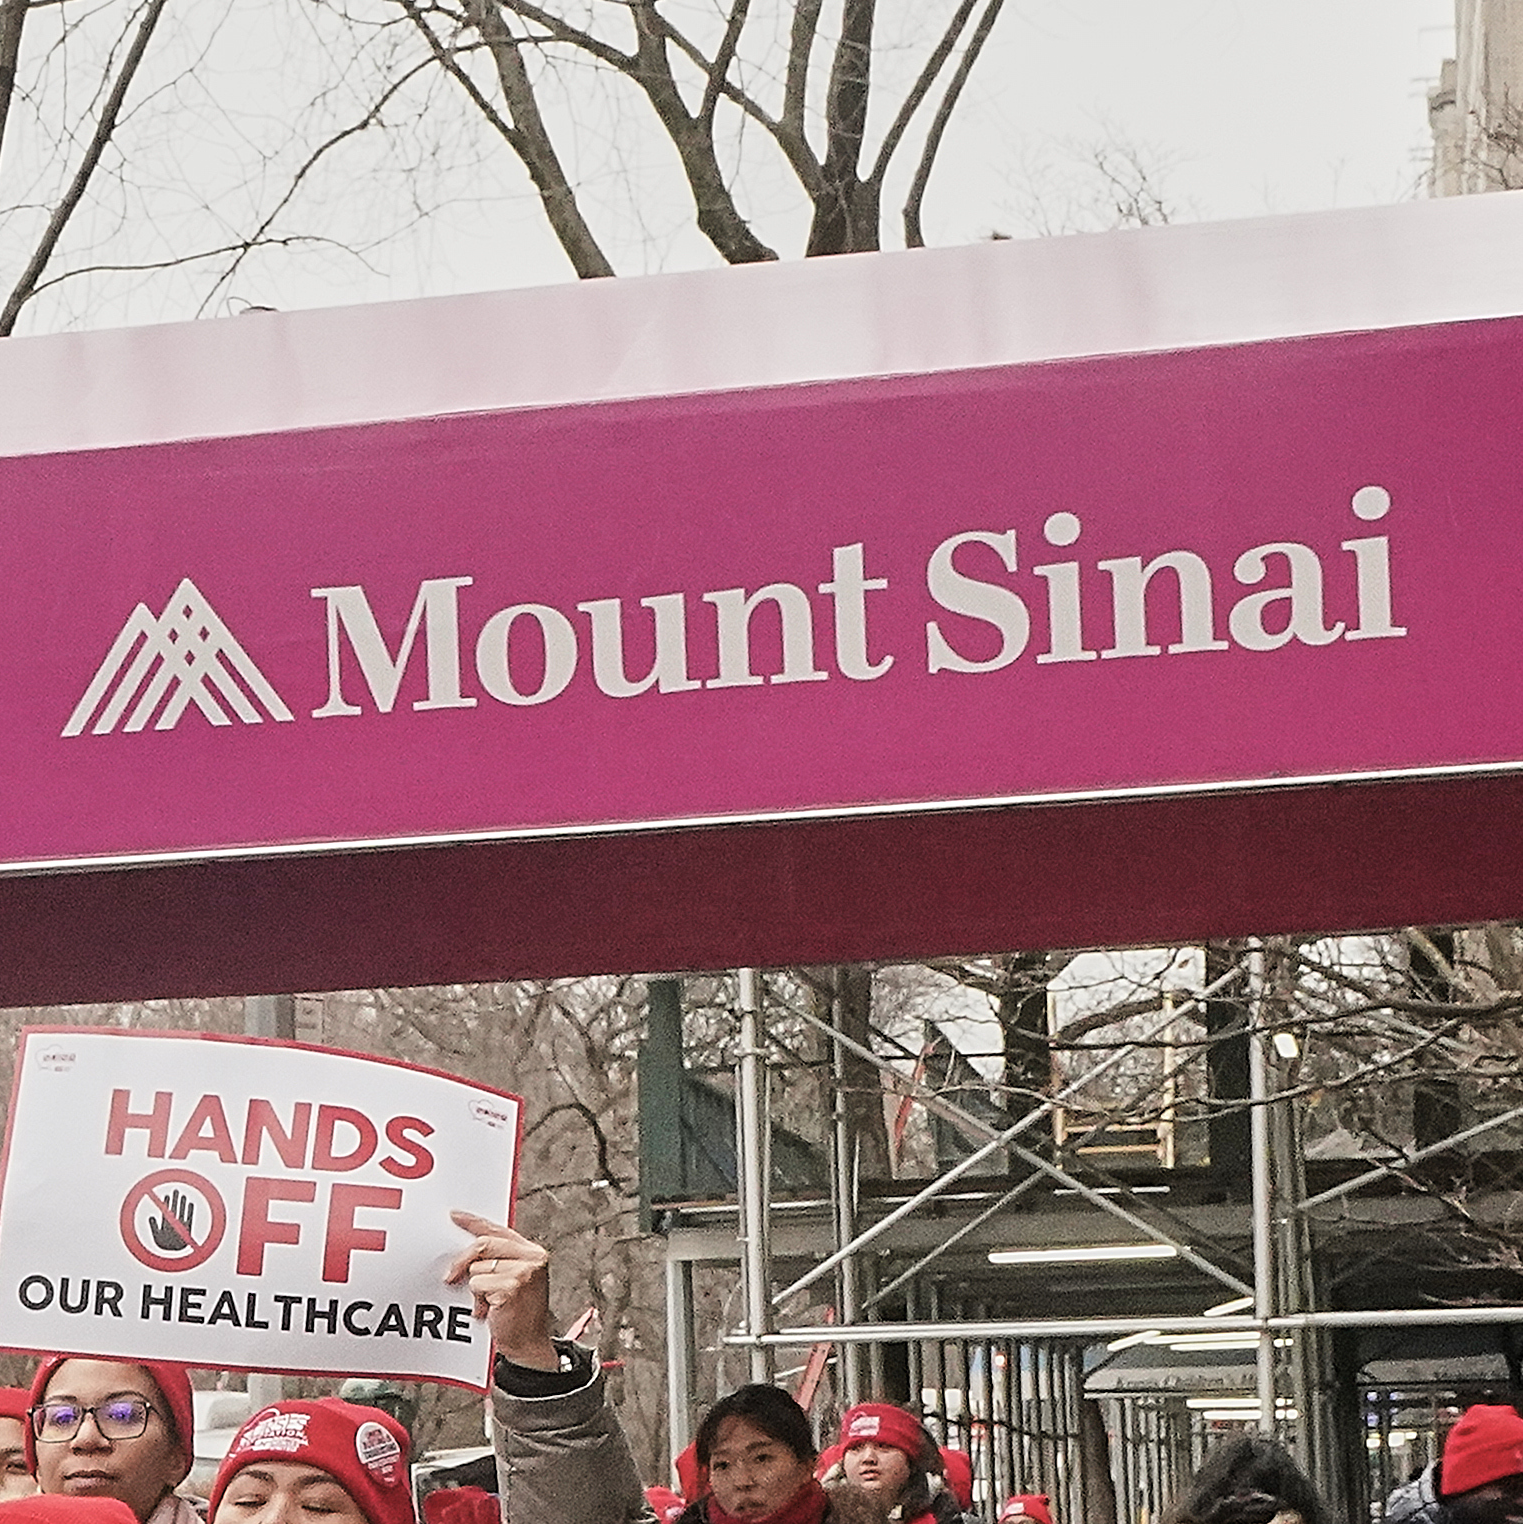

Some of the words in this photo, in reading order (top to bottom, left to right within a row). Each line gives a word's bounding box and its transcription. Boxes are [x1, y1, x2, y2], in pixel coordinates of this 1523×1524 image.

[311, 542, 893, 720] Mount
[926, 486, 1408, 676] Sinai
[104, 1088, 435, 1180] HANDS
[120, 1168, 403, 1284] OFF
[19, 1275, 125, 1319] OUR
[141, 1283, 473, 1344] HEALTHCARE
